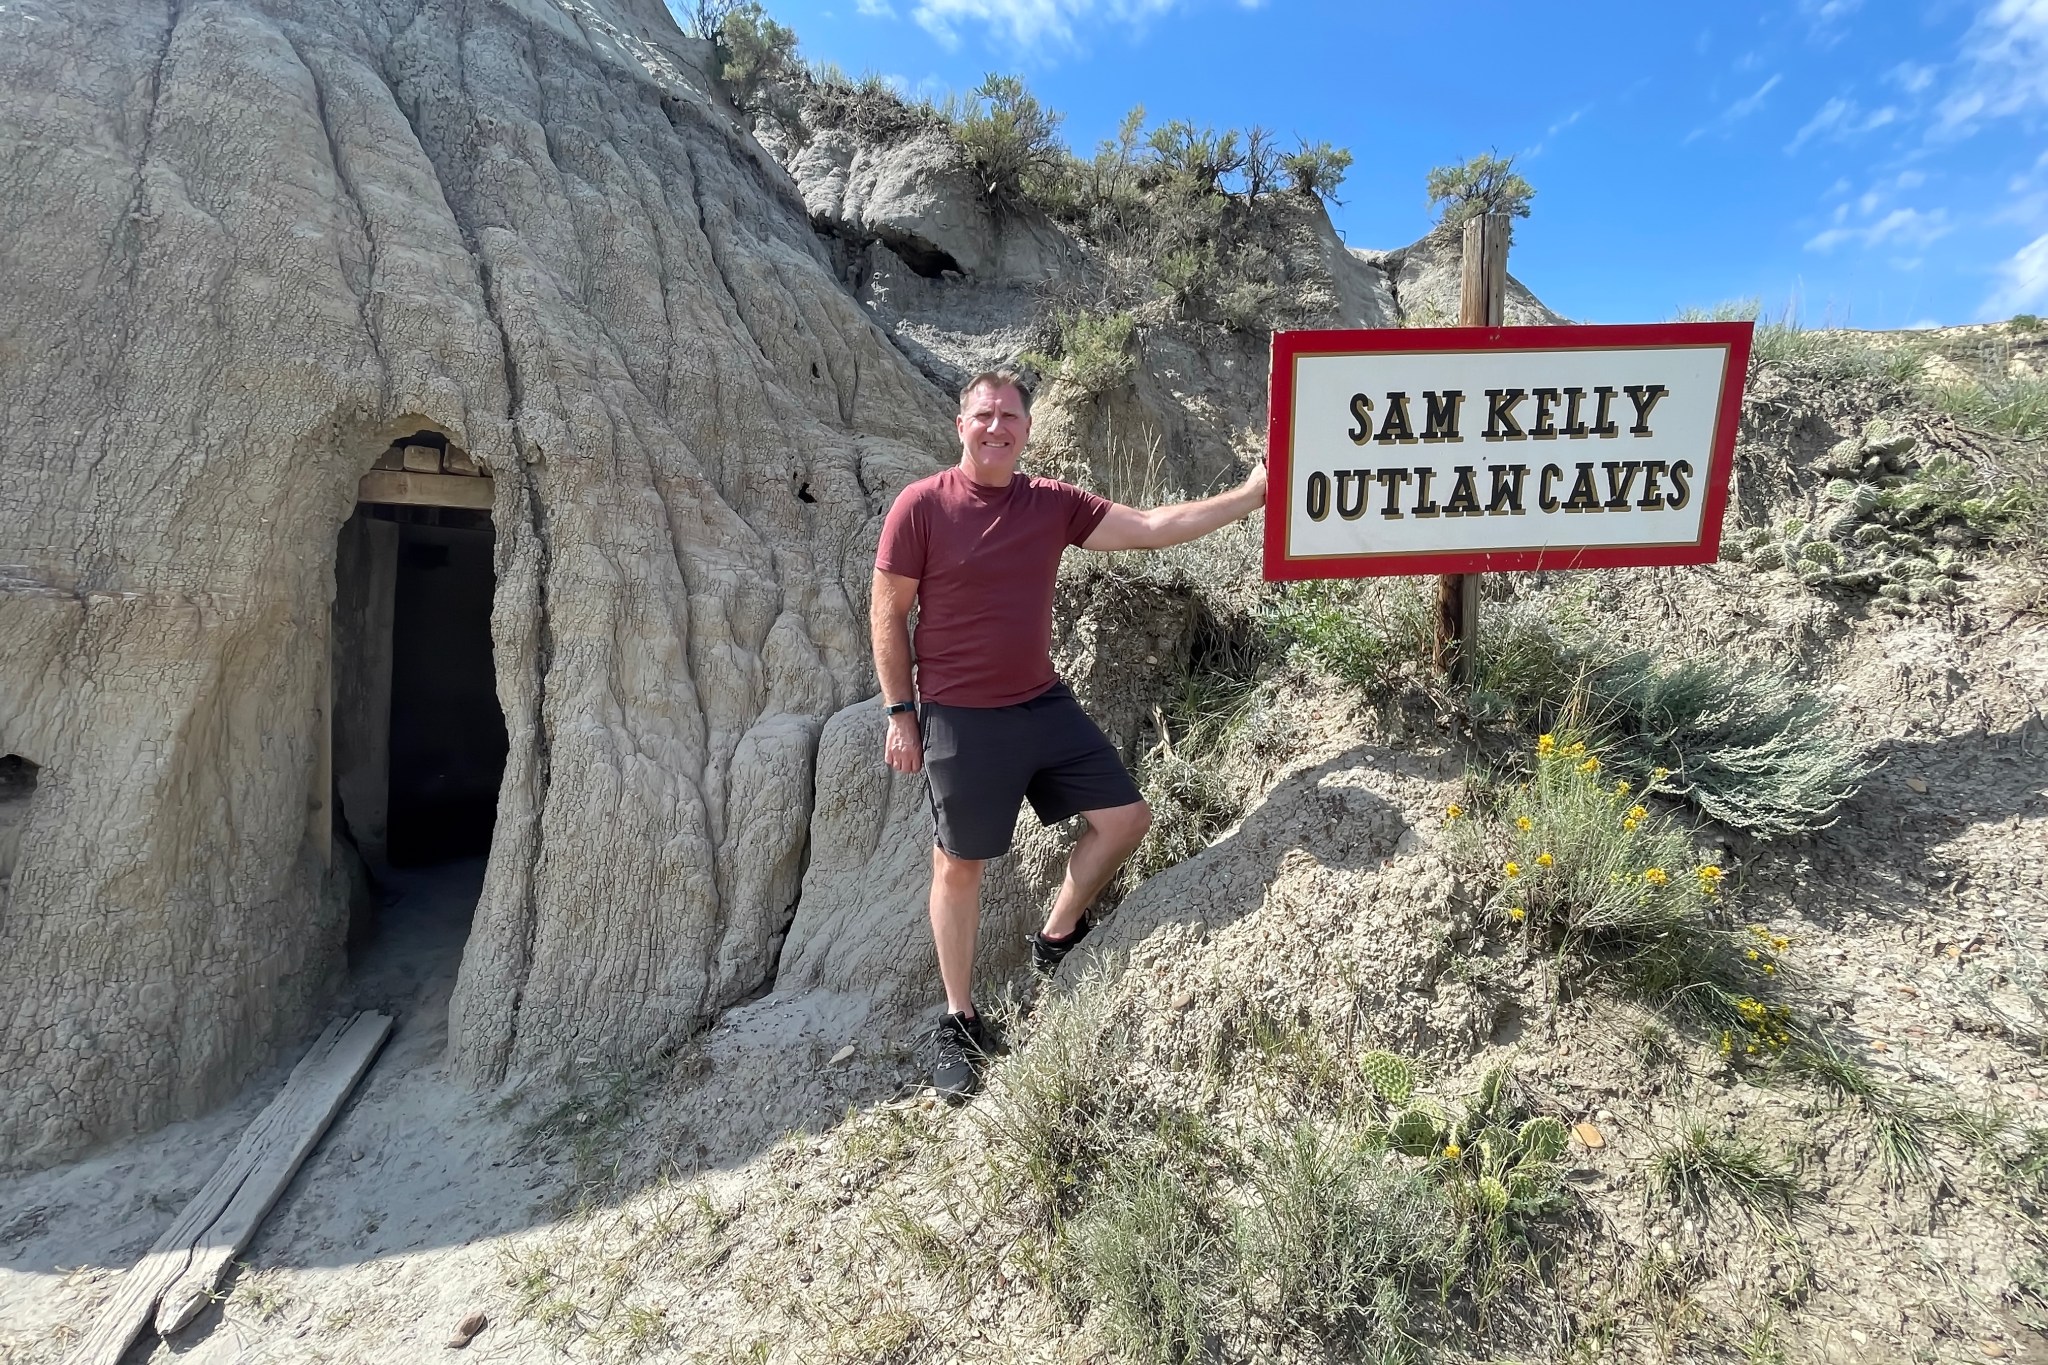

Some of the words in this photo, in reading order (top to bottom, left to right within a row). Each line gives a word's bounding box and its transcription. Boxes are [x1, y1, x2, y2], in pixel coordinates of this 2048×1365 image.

[1348, 389, 1466, 446] SAM
[1481, 384, 1670, 442] KELLY
[1306, 463, 1531, 521] OUTLAW
[1538, 459, 1694, 514] CAVES
